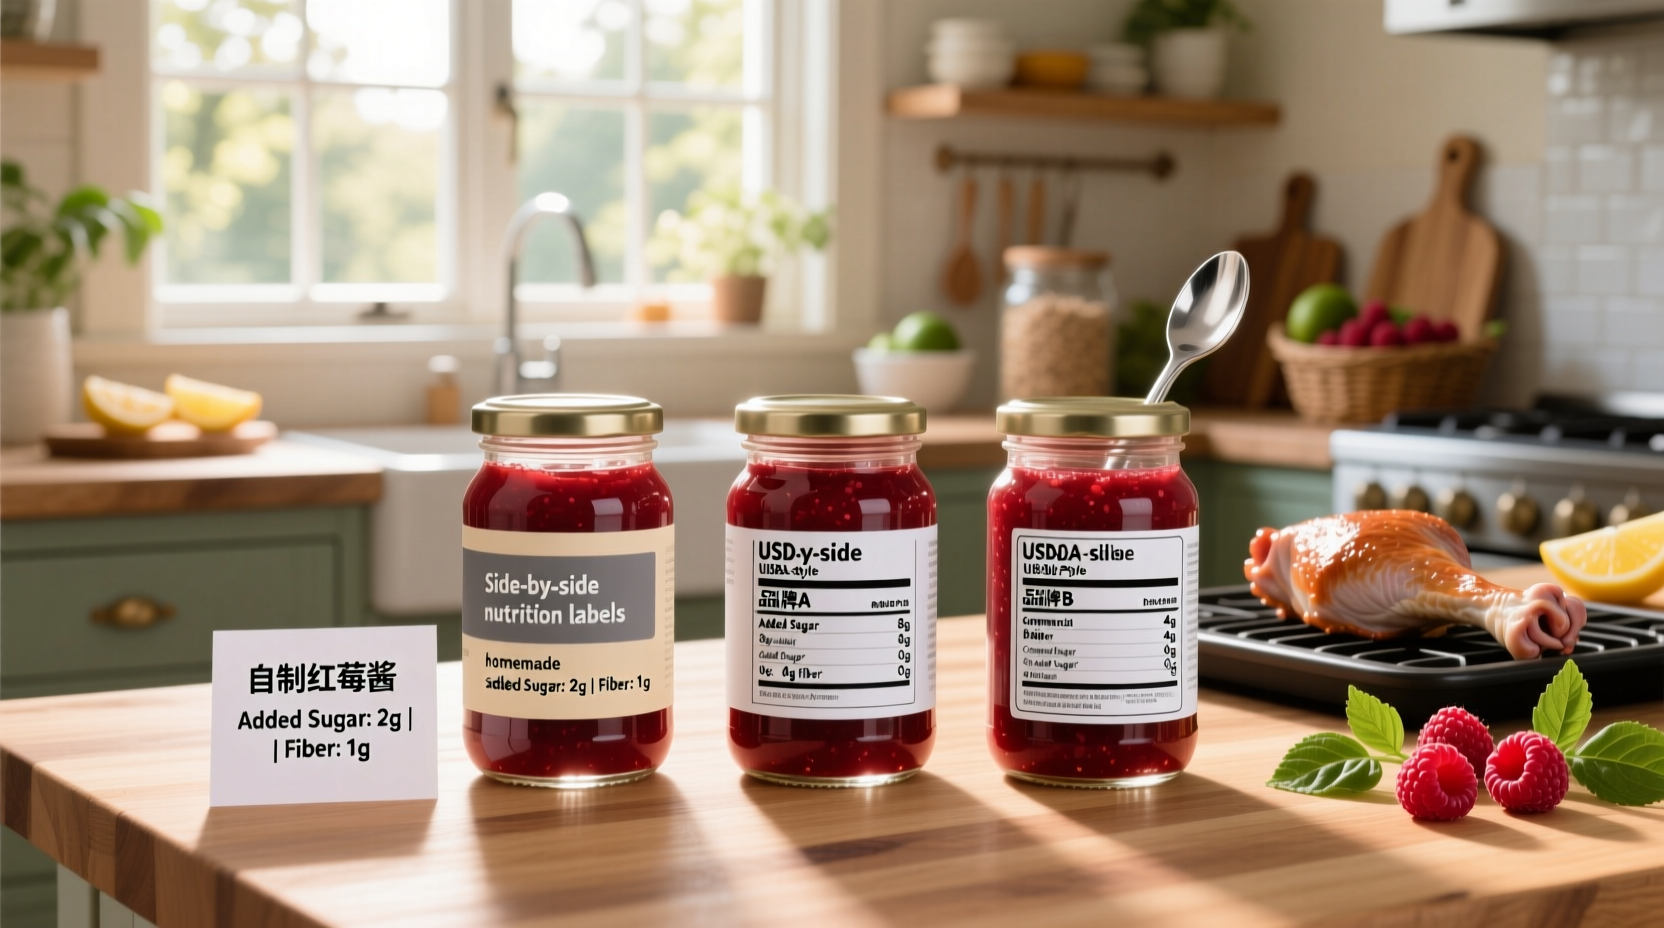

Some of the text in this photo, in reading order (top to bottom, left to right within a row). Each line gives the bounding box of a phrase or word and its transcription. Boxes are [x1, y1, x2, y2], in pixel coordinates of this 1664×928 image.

[484, 572, 599, 600] Side-by-side
[484, 601, 626, 625] nutrition labels
[1163, 614, 1176, 629] 4g
[485, 652, 561, 671] homemade
[250, 660, 397, 695] 自制红莓酱
[523, 678, 565, 697] Sugar:
[569, 678, 587, 697] 2g
[599, 676, 634, 692] Fiber:
[637, 674, 651, 692] 1g
[237, 709, 302, 730] Added
[308, 708, 372, 733] Sugar:
[377, 708, 402, 732] 2g
[285, 738, 341, 759] Fiber:
[346, 738, 370, 762] 1g
